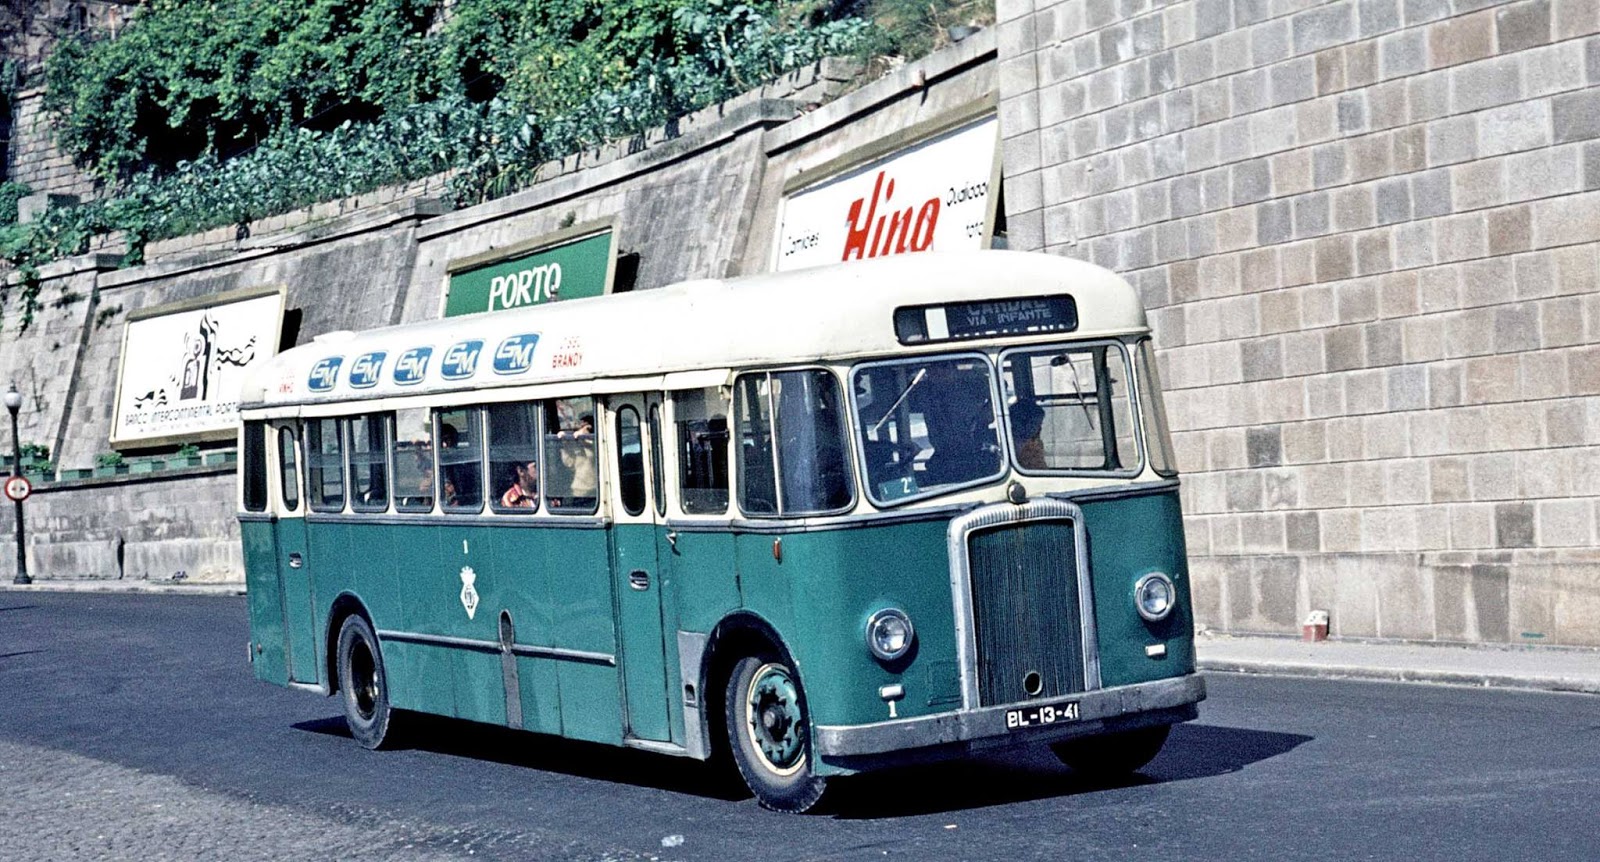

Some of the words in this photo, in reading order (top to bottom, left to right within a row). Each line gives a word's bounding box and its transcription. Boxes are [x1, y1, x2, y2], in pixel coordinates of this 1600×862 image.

[842, 171, 940, 261] Hino
[488, 262, 562, 312] PORTO
[966, 314, 987, 326] VIA
[997, 309, 1052, 324] INFANTE
[552, 352, 583, 368] BRANDY
[125, 413, 149, 426] BANCO
[888, 700, 898, 718] 1
[1007, 702, 1079, 728] BL-13-41
